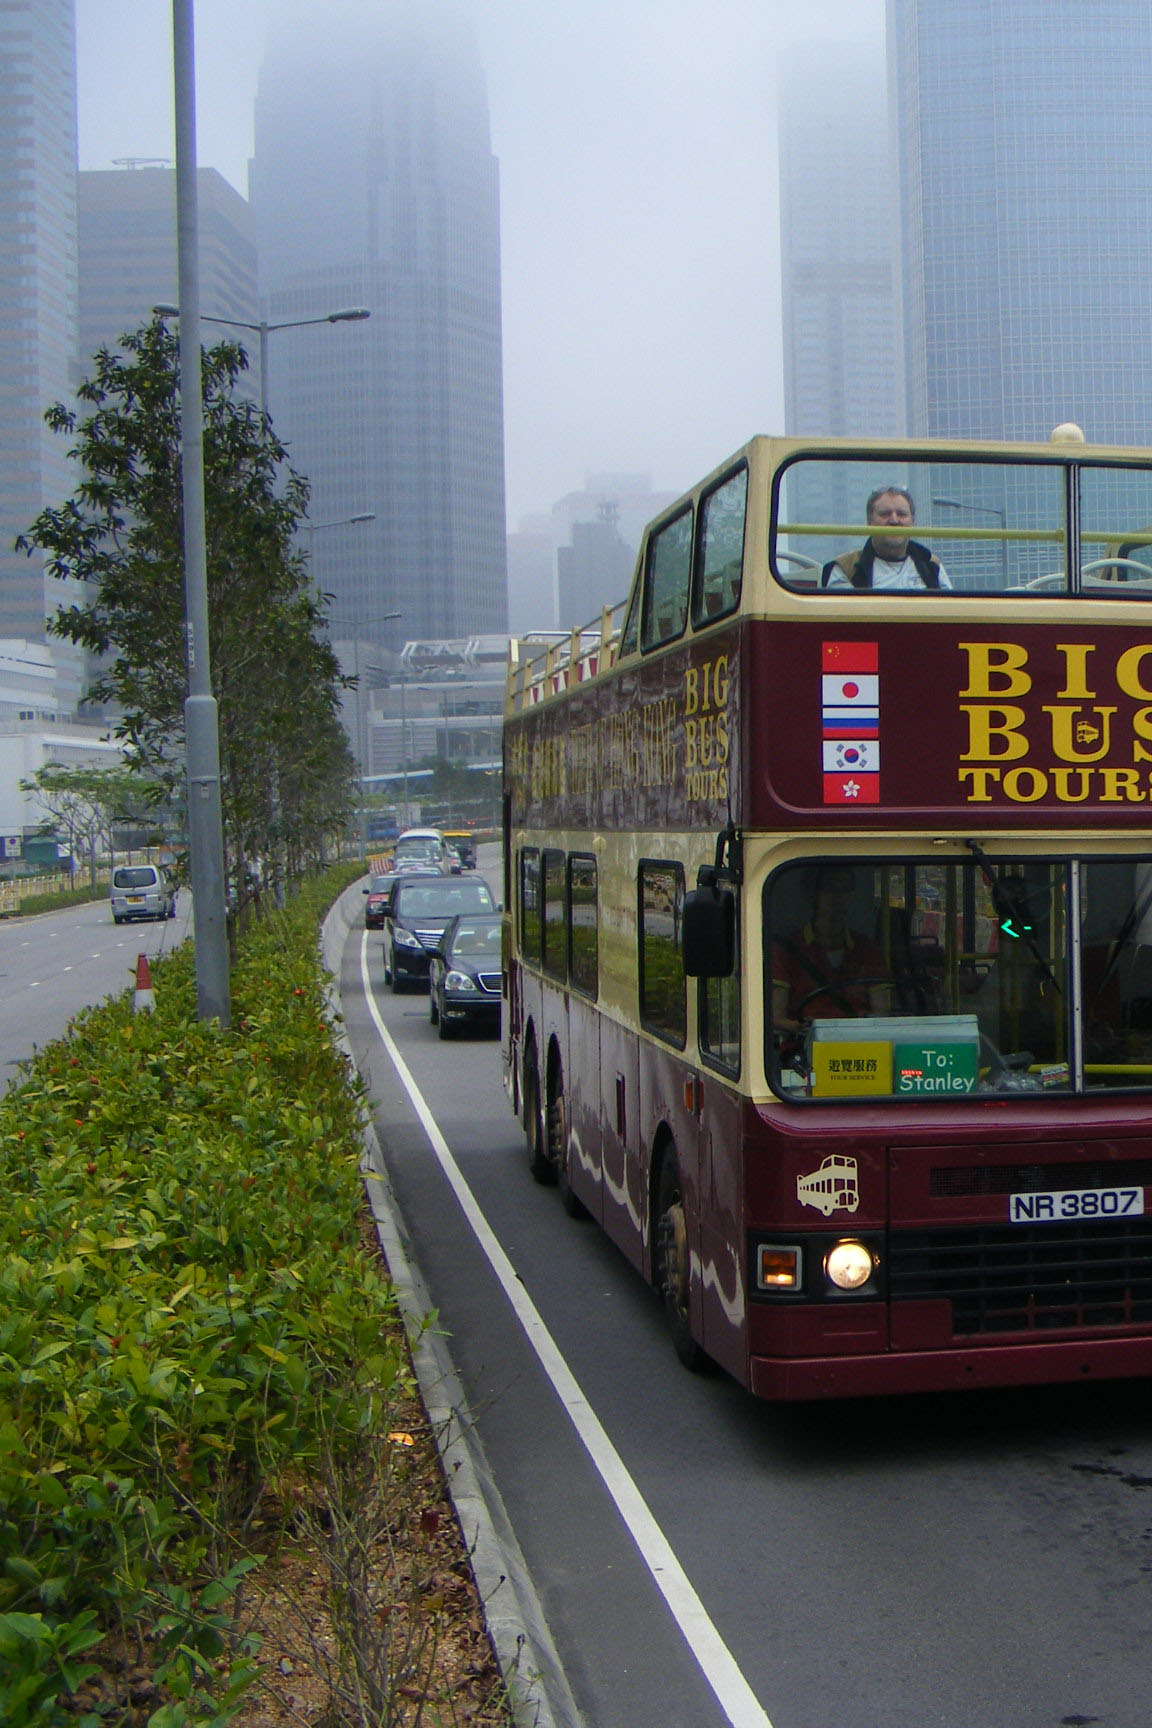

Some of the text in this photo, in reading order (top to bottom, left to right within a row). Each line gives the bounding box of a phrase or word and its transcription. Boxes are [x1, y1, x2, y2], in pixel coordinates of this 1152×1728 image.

[684, 655, 729, 715] BIG
[684, 712, 730, 768] BUS
[684, 768, 728, 800] TOURS
[828, 1059, 878, 1073] 遊覽服務
[922, 1050, 953, 1068] To:
[900, 1072, 975, 1093] Stanley
[1014, 1190, 1138, 1220] NR 3807
